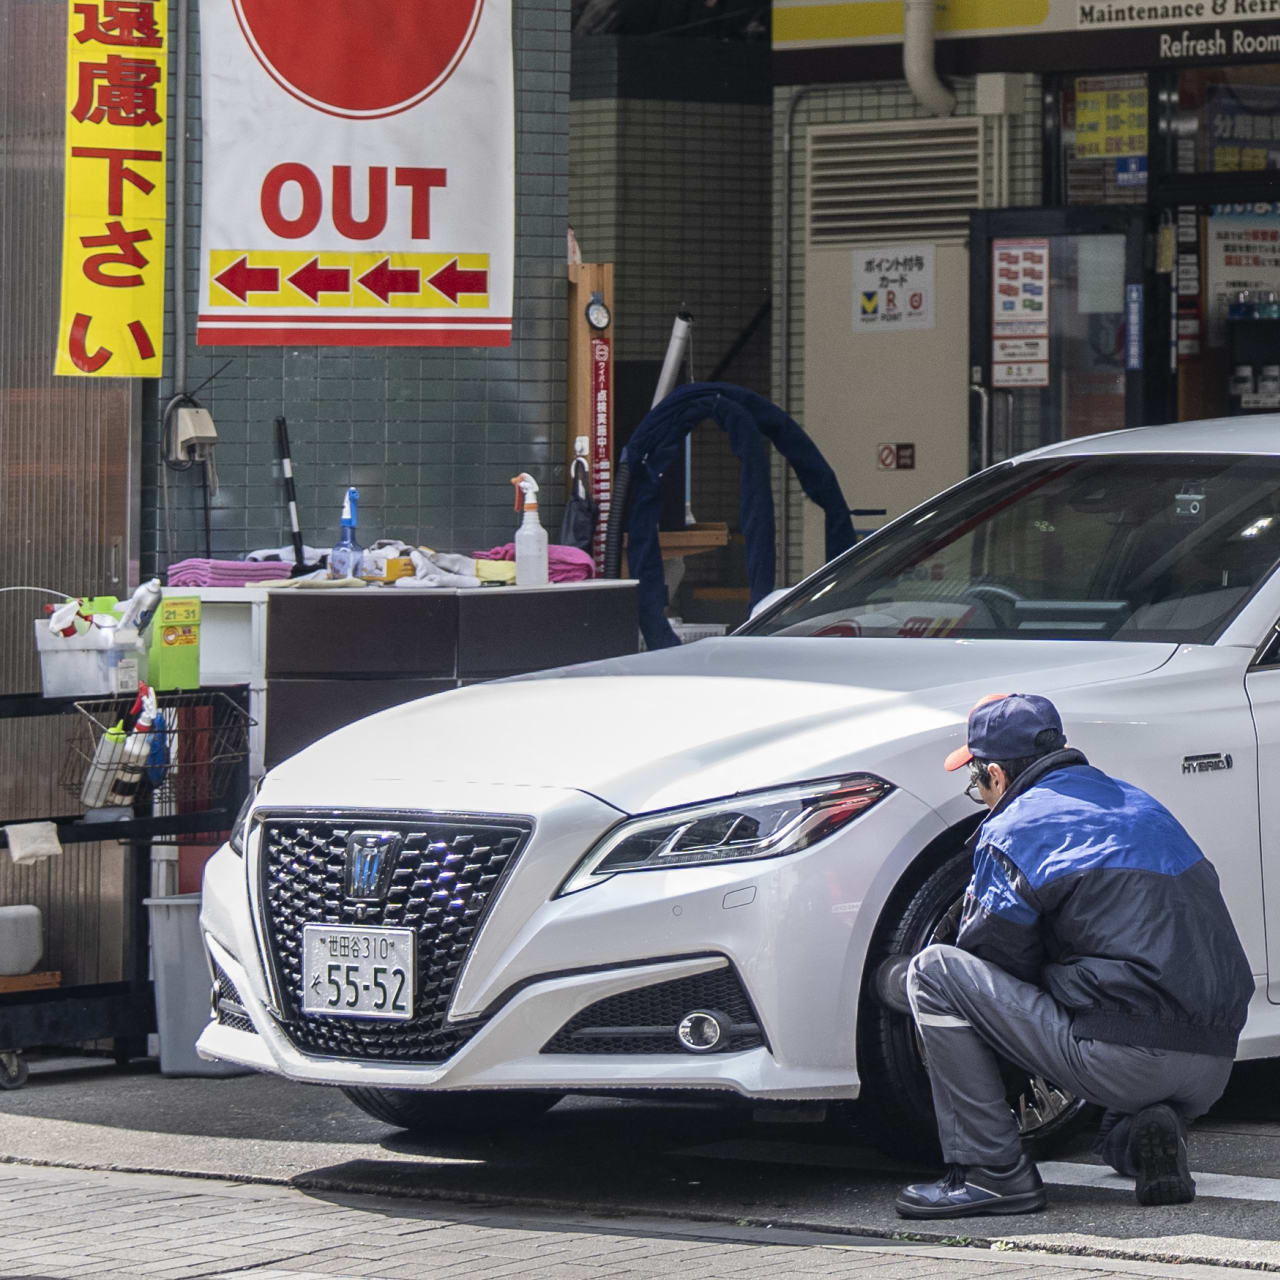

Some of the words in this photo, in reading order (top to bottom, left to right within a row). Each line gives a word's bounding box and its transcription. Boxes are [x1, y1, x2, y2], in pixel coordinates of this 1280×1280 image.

[1160, 30, 1227, 58] Refresh
[260, 162, 447, 240] OUT
[327, 964, 406, 1011] 55-52
